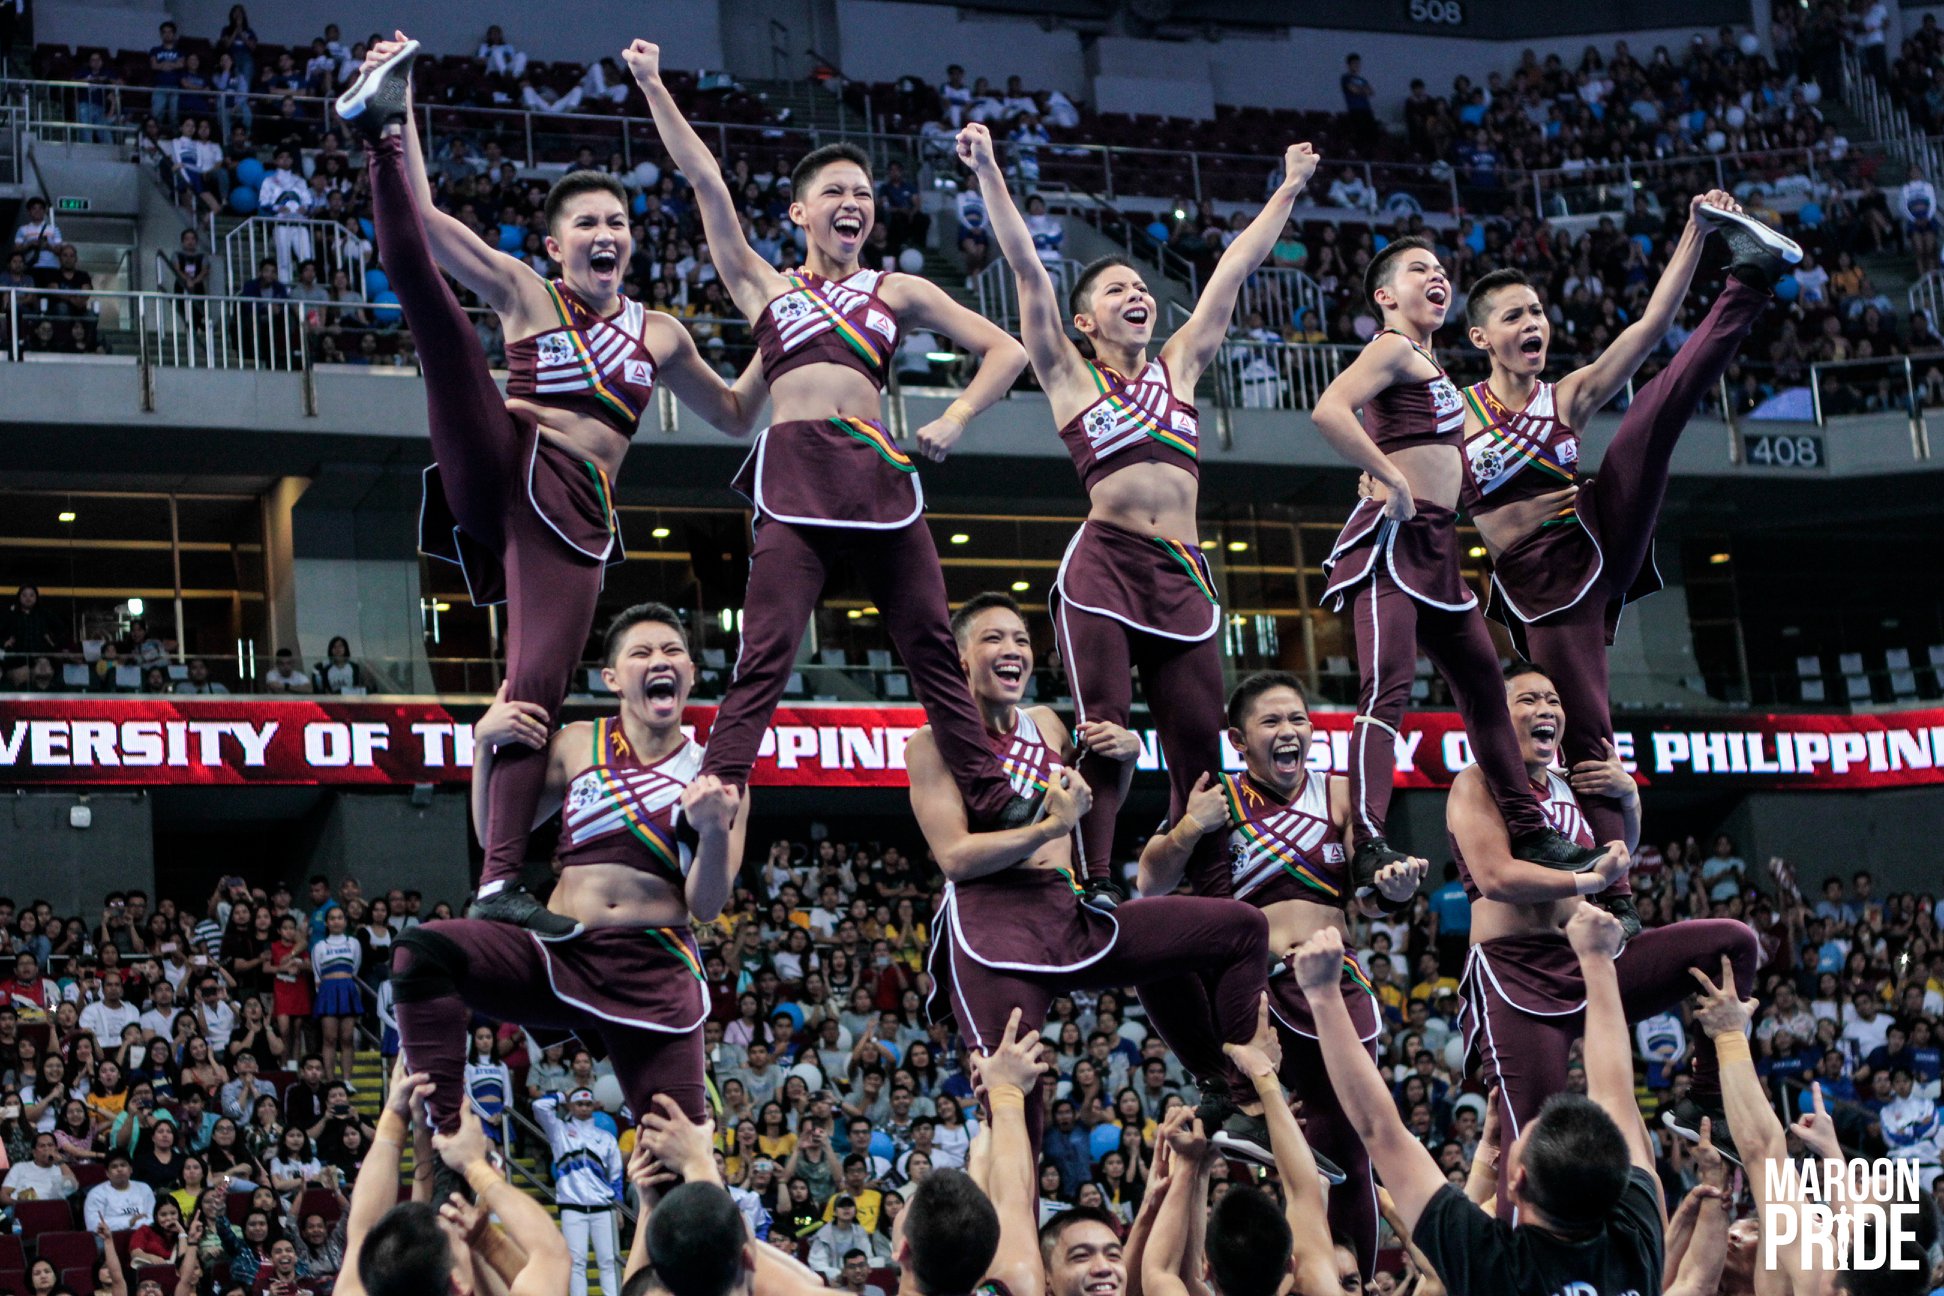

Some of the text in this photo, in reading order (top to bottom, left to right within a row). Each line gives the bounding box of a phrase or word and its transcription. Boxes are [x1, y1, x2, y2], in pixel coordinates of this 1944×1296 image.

[1410, 0, 1462, 24] 508
[1753, 436, 1817, 467] 408
[304, 721, 389, 767] OF
